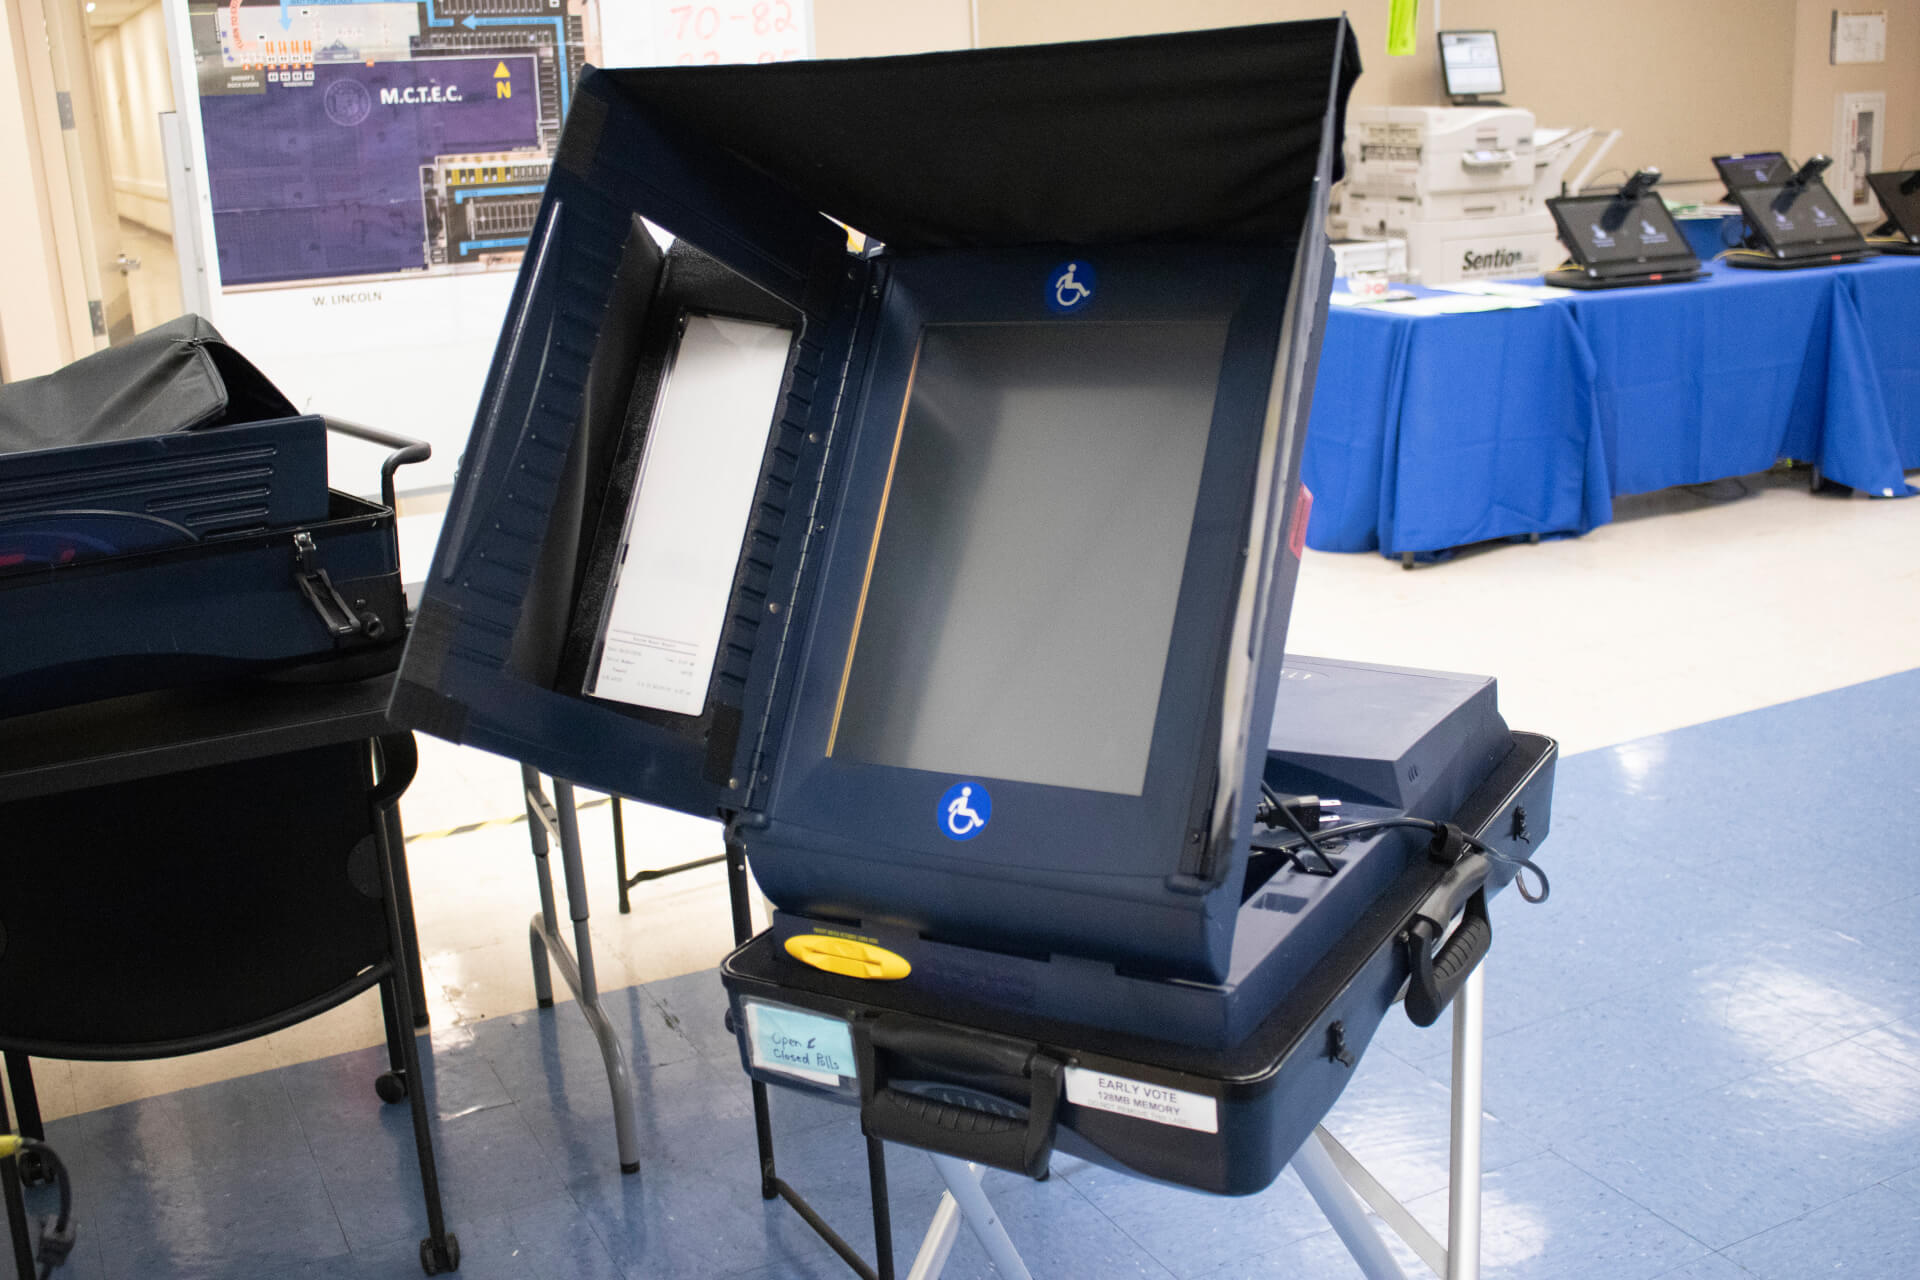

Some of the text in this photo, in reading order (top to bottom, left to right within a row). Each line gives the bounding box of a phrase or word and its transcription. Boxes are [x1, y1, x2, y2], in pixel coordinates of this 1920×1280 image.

[380, 85, 463, 104] M.C.T.E.C.
[496, 81, 511, 99] N
[331, 291, 383, 305] LINCOLN
[772, 1033, 802, 1048] Open
[773, 1048, 810, 1064] Closed
[1098, 1078, 1178, 1104] EARLY VOTE
[1097, 1091, 1181, 1115] 128MB MEMORY
